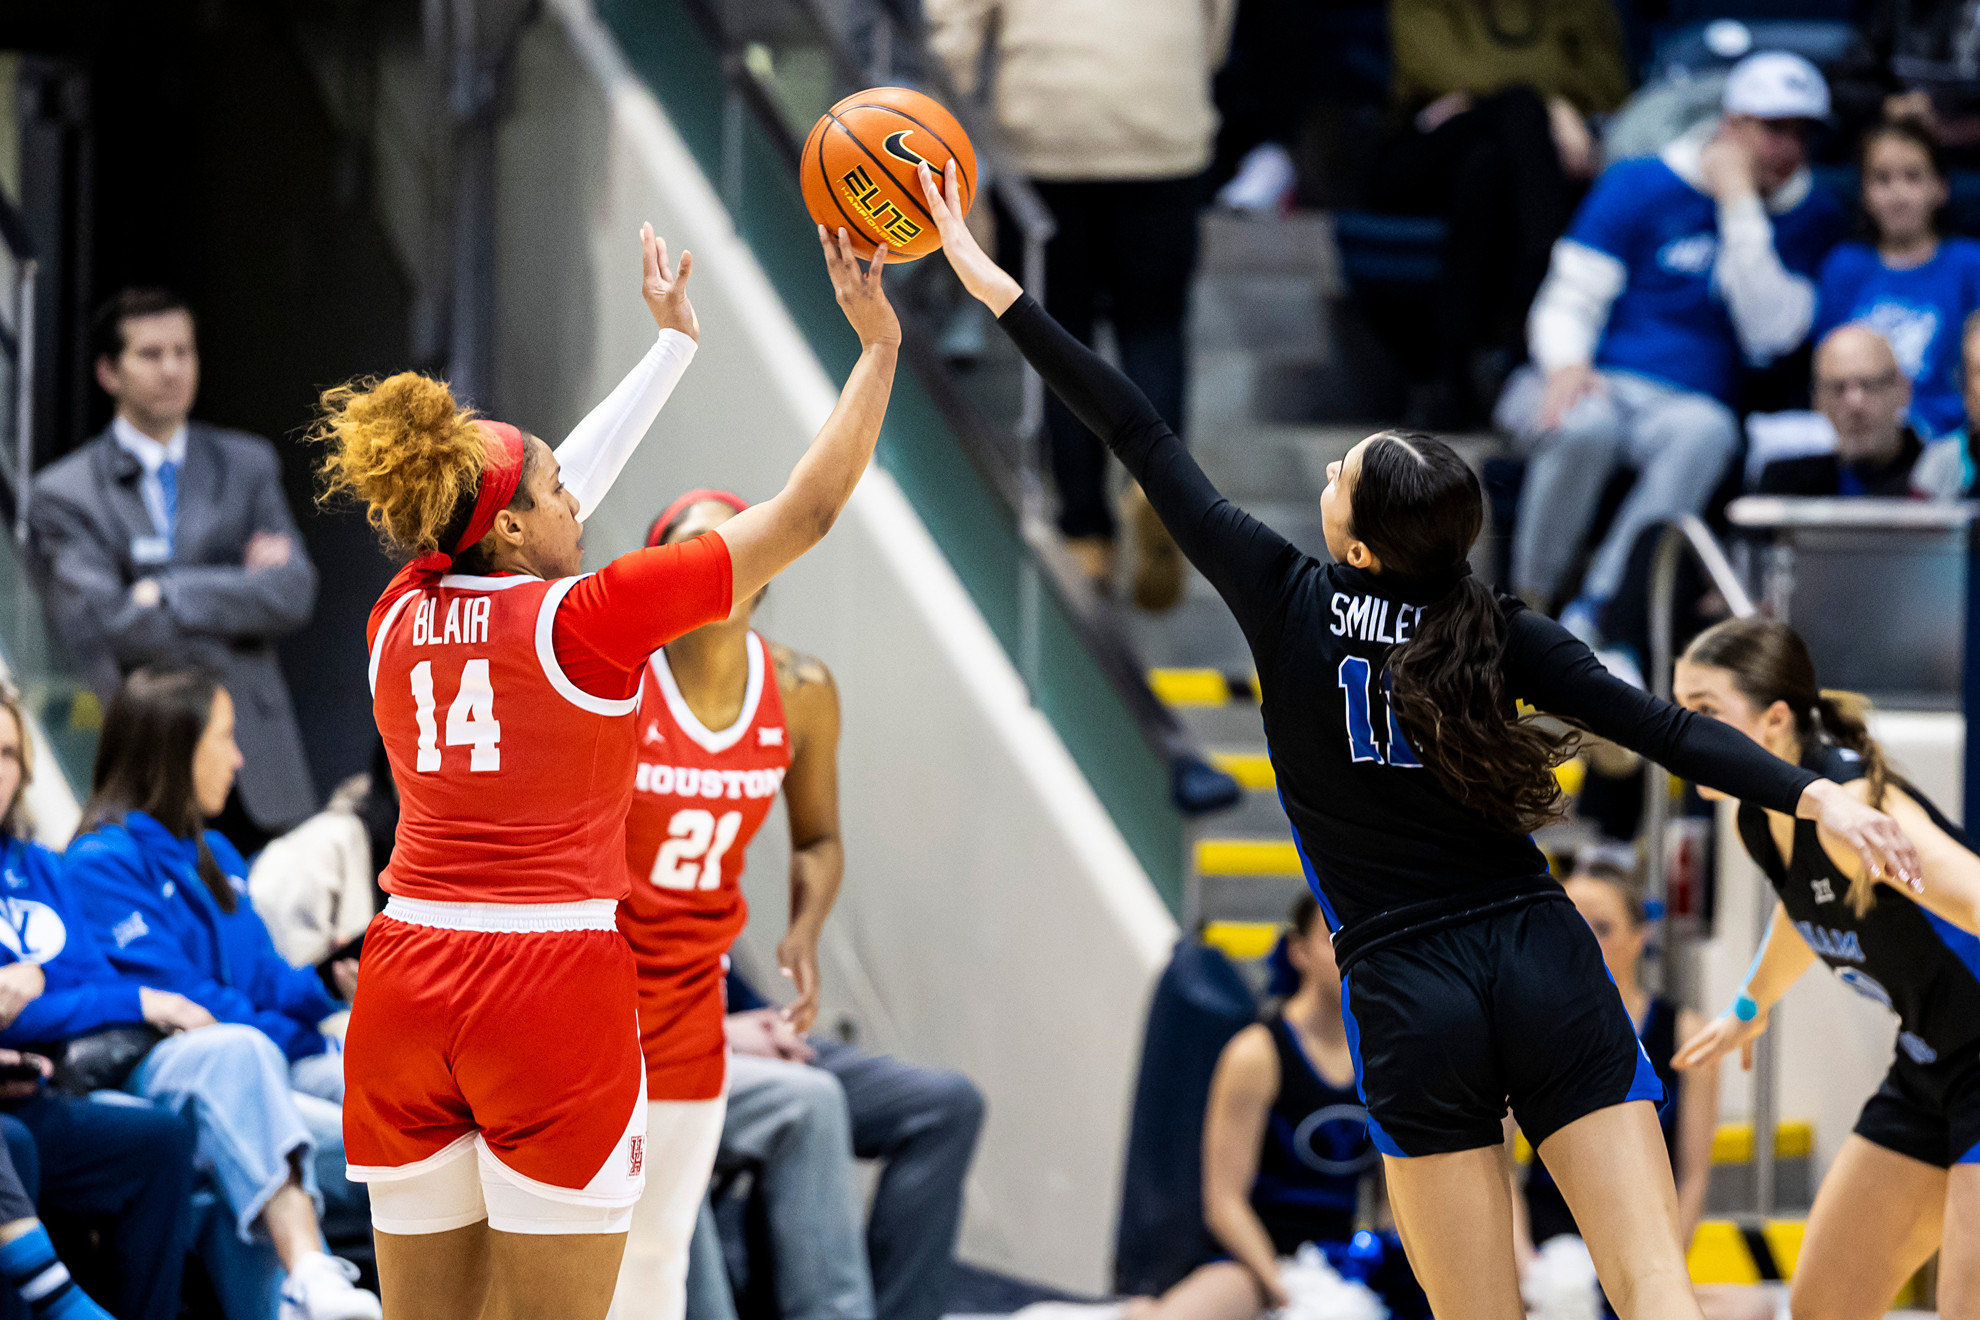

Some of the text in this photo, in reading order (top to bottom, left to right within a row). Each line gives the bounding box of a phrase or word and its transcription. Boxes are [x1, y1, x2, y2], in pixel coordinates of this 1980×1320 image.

[835, 178, 904, 248] HAMPIONSHIP
[412, 596, 491, 646] BLAIR
[410, 658, 501, 772] 14
[650, 809, 743, 891] 21
